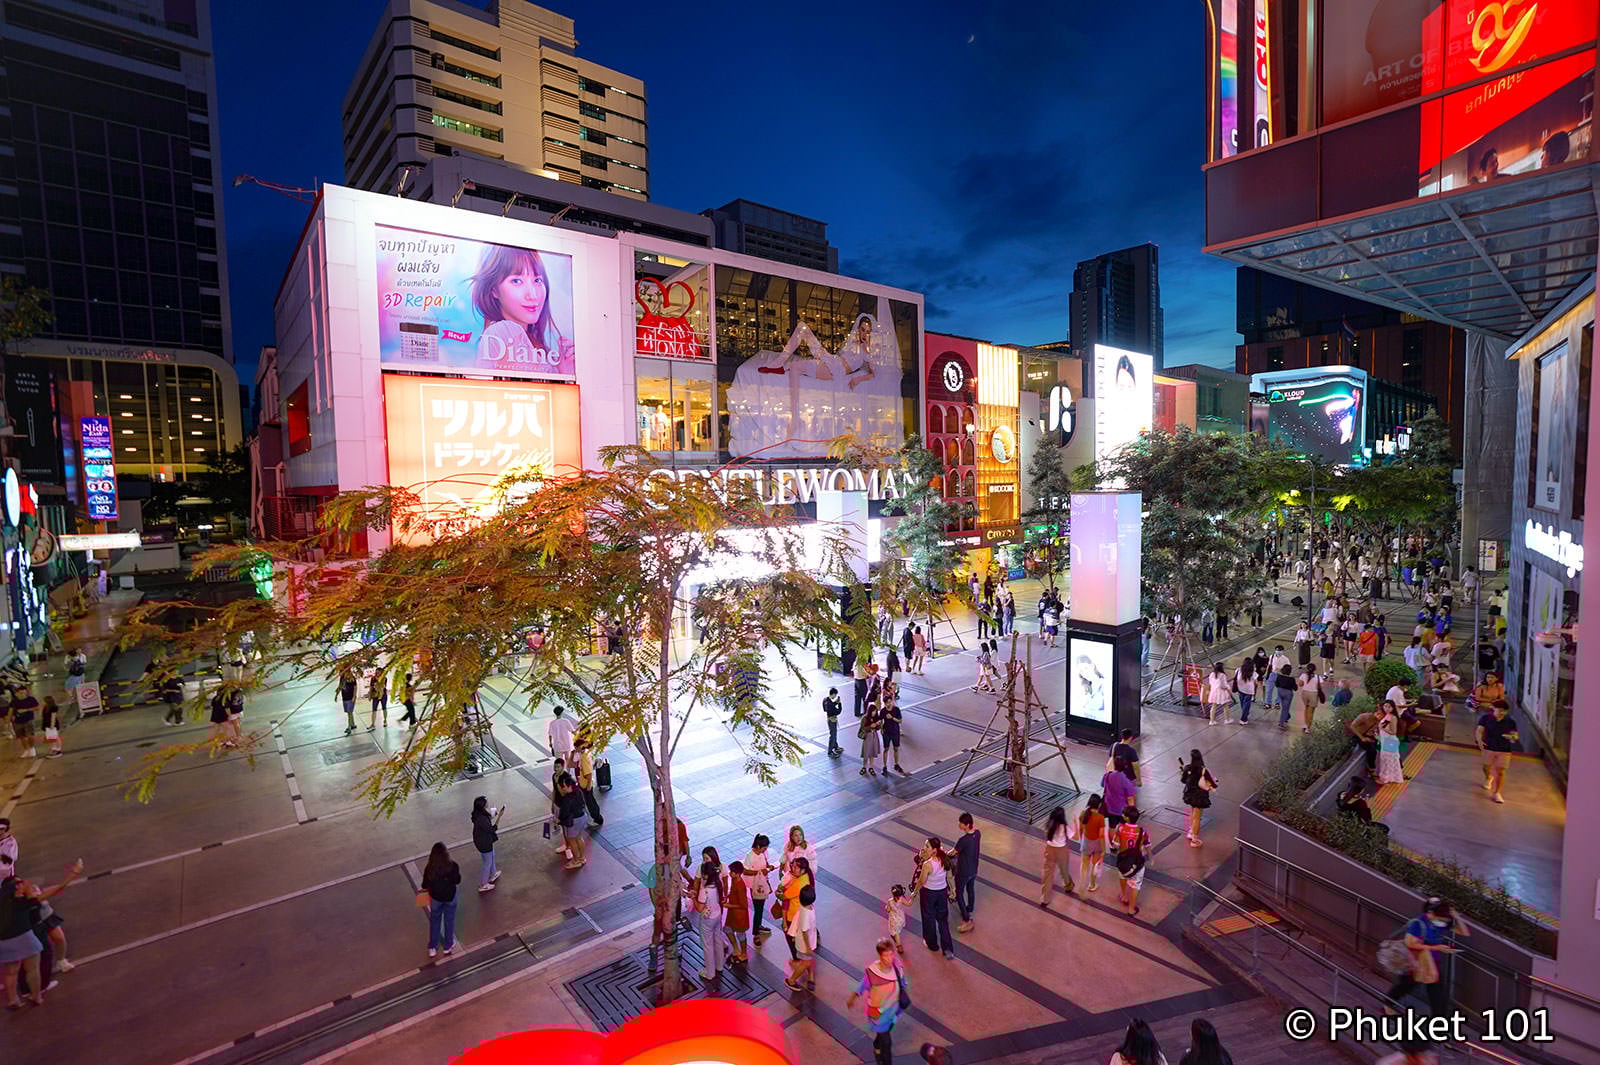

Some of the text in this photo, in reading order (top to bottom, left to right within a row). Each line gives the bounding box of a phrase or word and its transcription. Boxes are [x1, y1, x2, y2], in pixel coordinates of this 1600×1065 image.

[1363, 59, 1405, 86] ART
[1409, 49, 1440, 69] OF
[379, 239, 455, 258] จบทุกปัญหา
[397, 259, 440, 273] ผมเสีย
[384, 291, 457, 311] 3D Repair
[480, 334, 560, 366] Diane
[433, 441, 520, 468] ドラッグ
